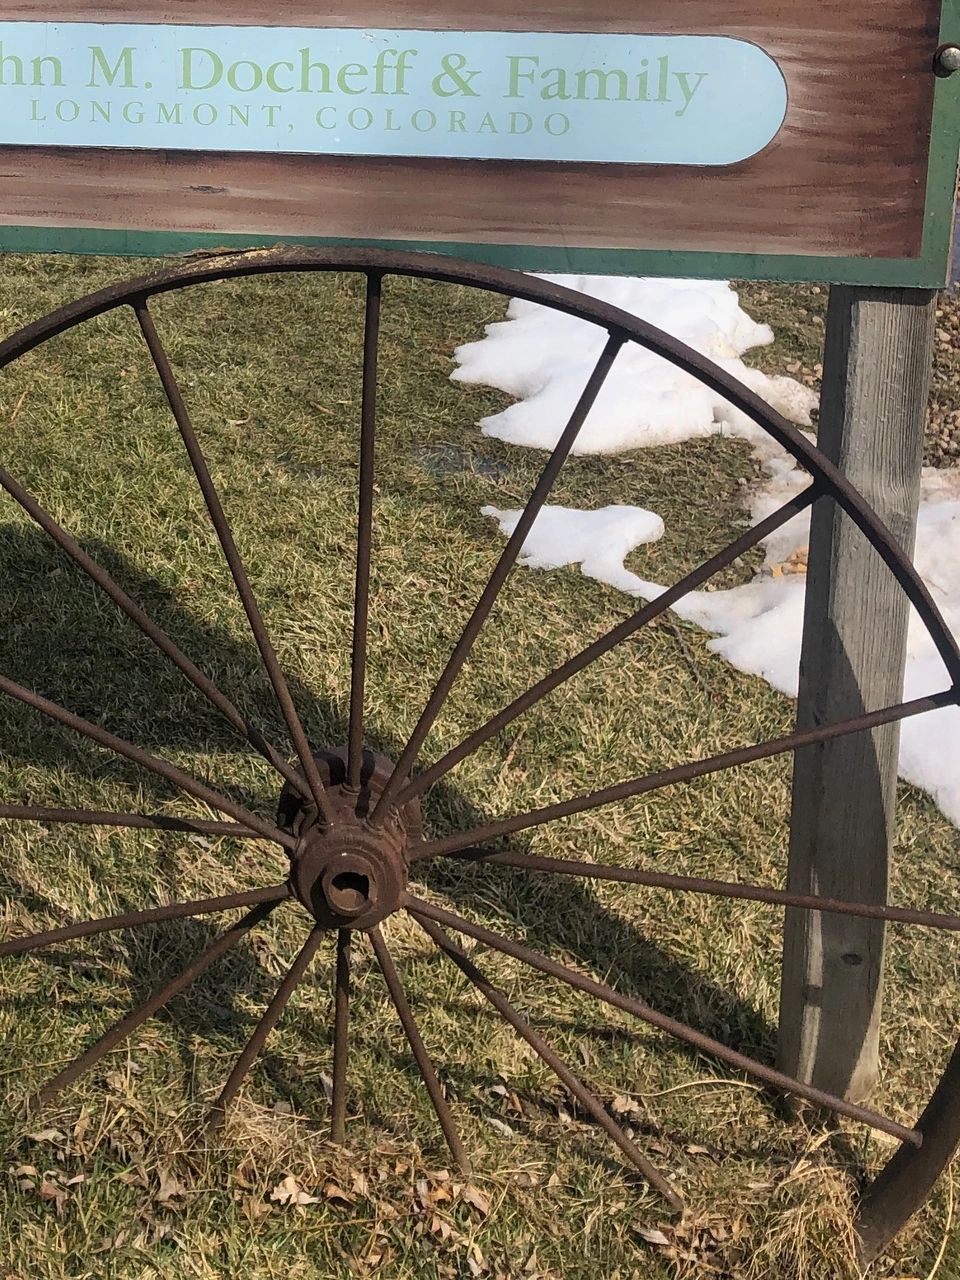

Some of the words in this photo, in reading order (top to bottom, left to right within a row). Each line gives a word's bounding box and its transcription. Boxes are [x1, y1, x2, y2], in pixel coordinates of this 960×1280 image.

[85, 46, 153, 90] M.
[177, 46, 418, 95] Docheff
[431, 52, 482, 98] &
[503, 55, 709, 116] Family
[29, 98, 294, 131] LONGMONT,
[315, 106, 571, 136] COLORADO
